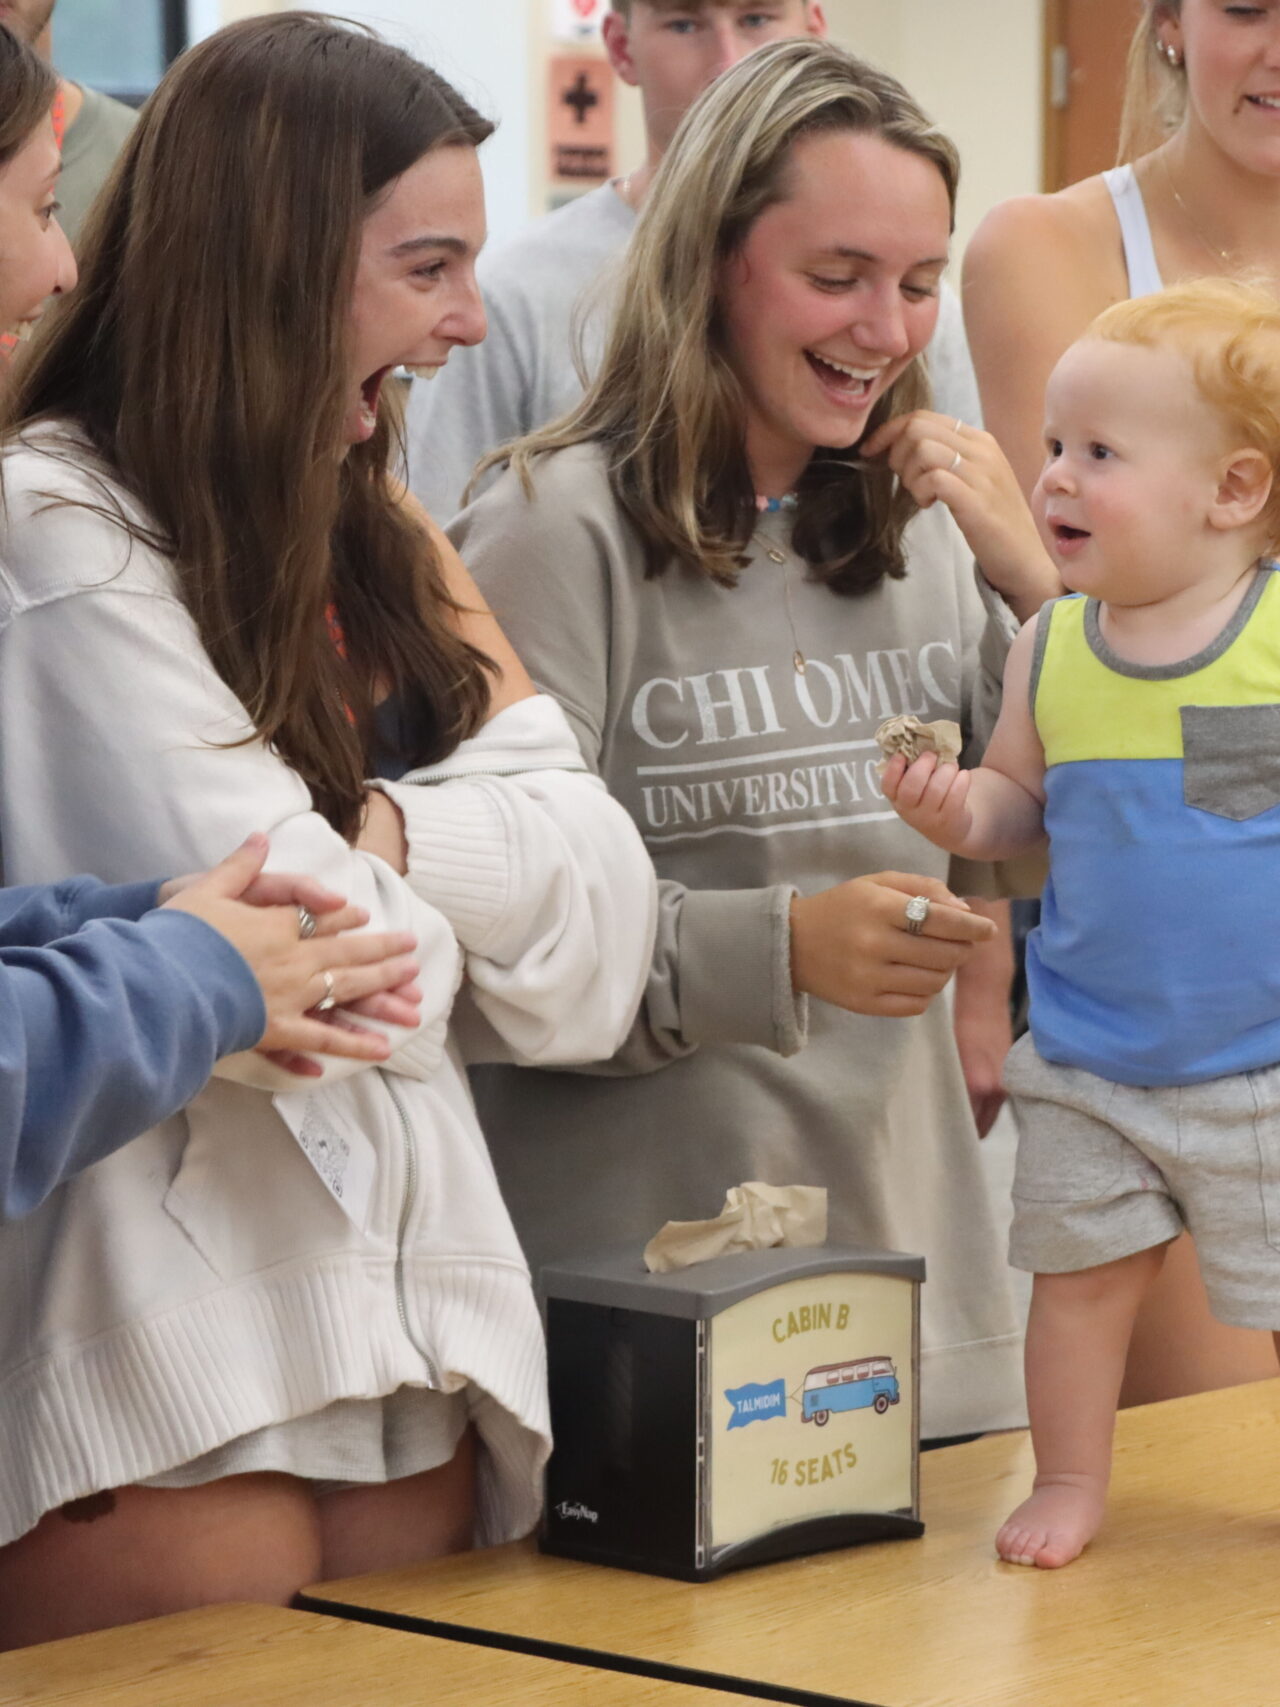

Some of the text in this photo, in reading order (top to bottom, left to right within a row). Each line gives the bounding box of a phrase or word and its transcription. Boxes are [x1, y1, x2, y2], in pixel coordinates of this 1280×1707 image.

[631, 639, 961, 749] CHI OMEG
[641, 761, 862, 828] UNIVERSITY
[772, 1303, 850, 1343] CABIN B
[737, 1392, 781, 1414] TALMIDIM
[770, 1442, 857, 1486] 16 SEATS
[561, 1501, 598, 1523] EasyNap
